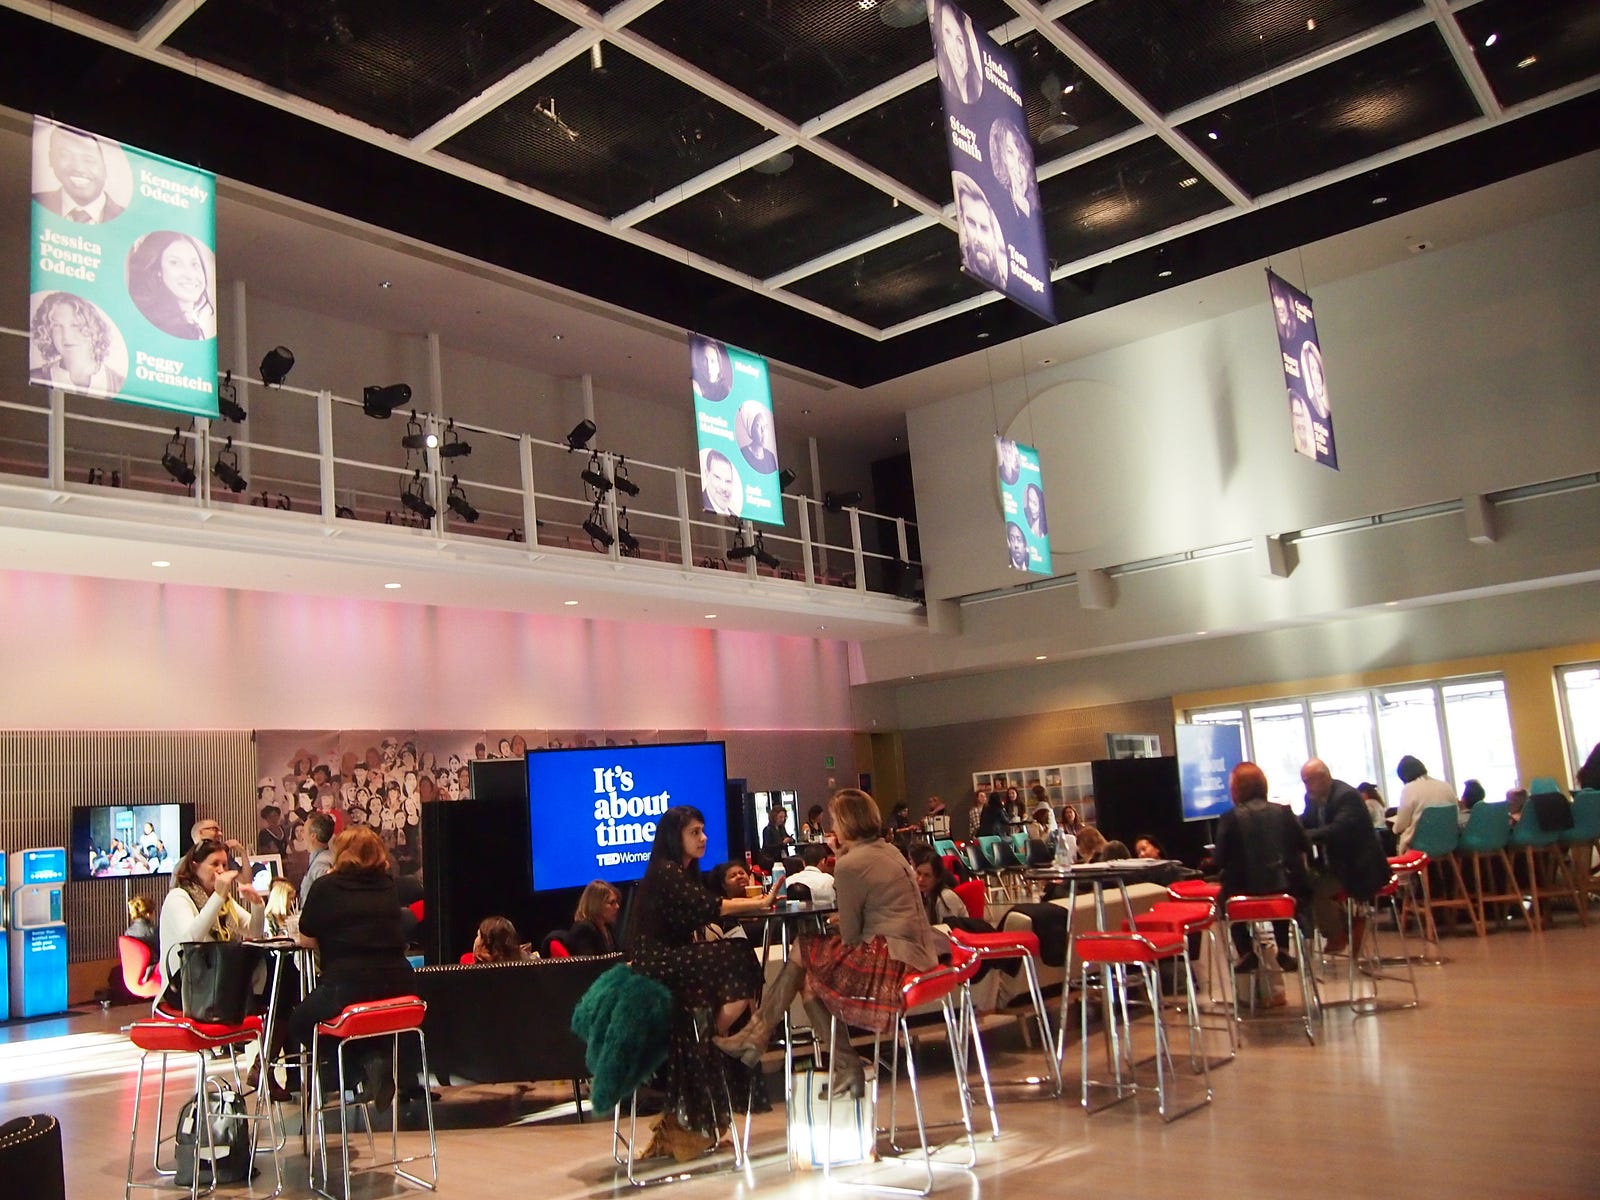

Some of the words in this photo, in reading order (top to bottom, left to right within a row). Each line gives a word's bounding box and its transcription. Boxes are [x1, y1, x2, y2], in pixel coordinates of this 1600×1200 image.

[950, 115, 976, 145] Stacy
[952, 131, 982, 162] Smith
[140, 170, 208, 204] Kennedy
[140, 185, 190, 209] Odede
[40, 228, 101, 255] Jessica
[40, 243, 101, 268] Posner
[40, 258, 96, 282] Odede
[1008, 243, 1028, 269] Tom
[136, 351, 184, 374] Peggy
[136, 366, 213, 394] Orenstein
[593, 765, 634, 793] It's
[594, 790, 670, 820] about
[595, 817, 657, 847] time
